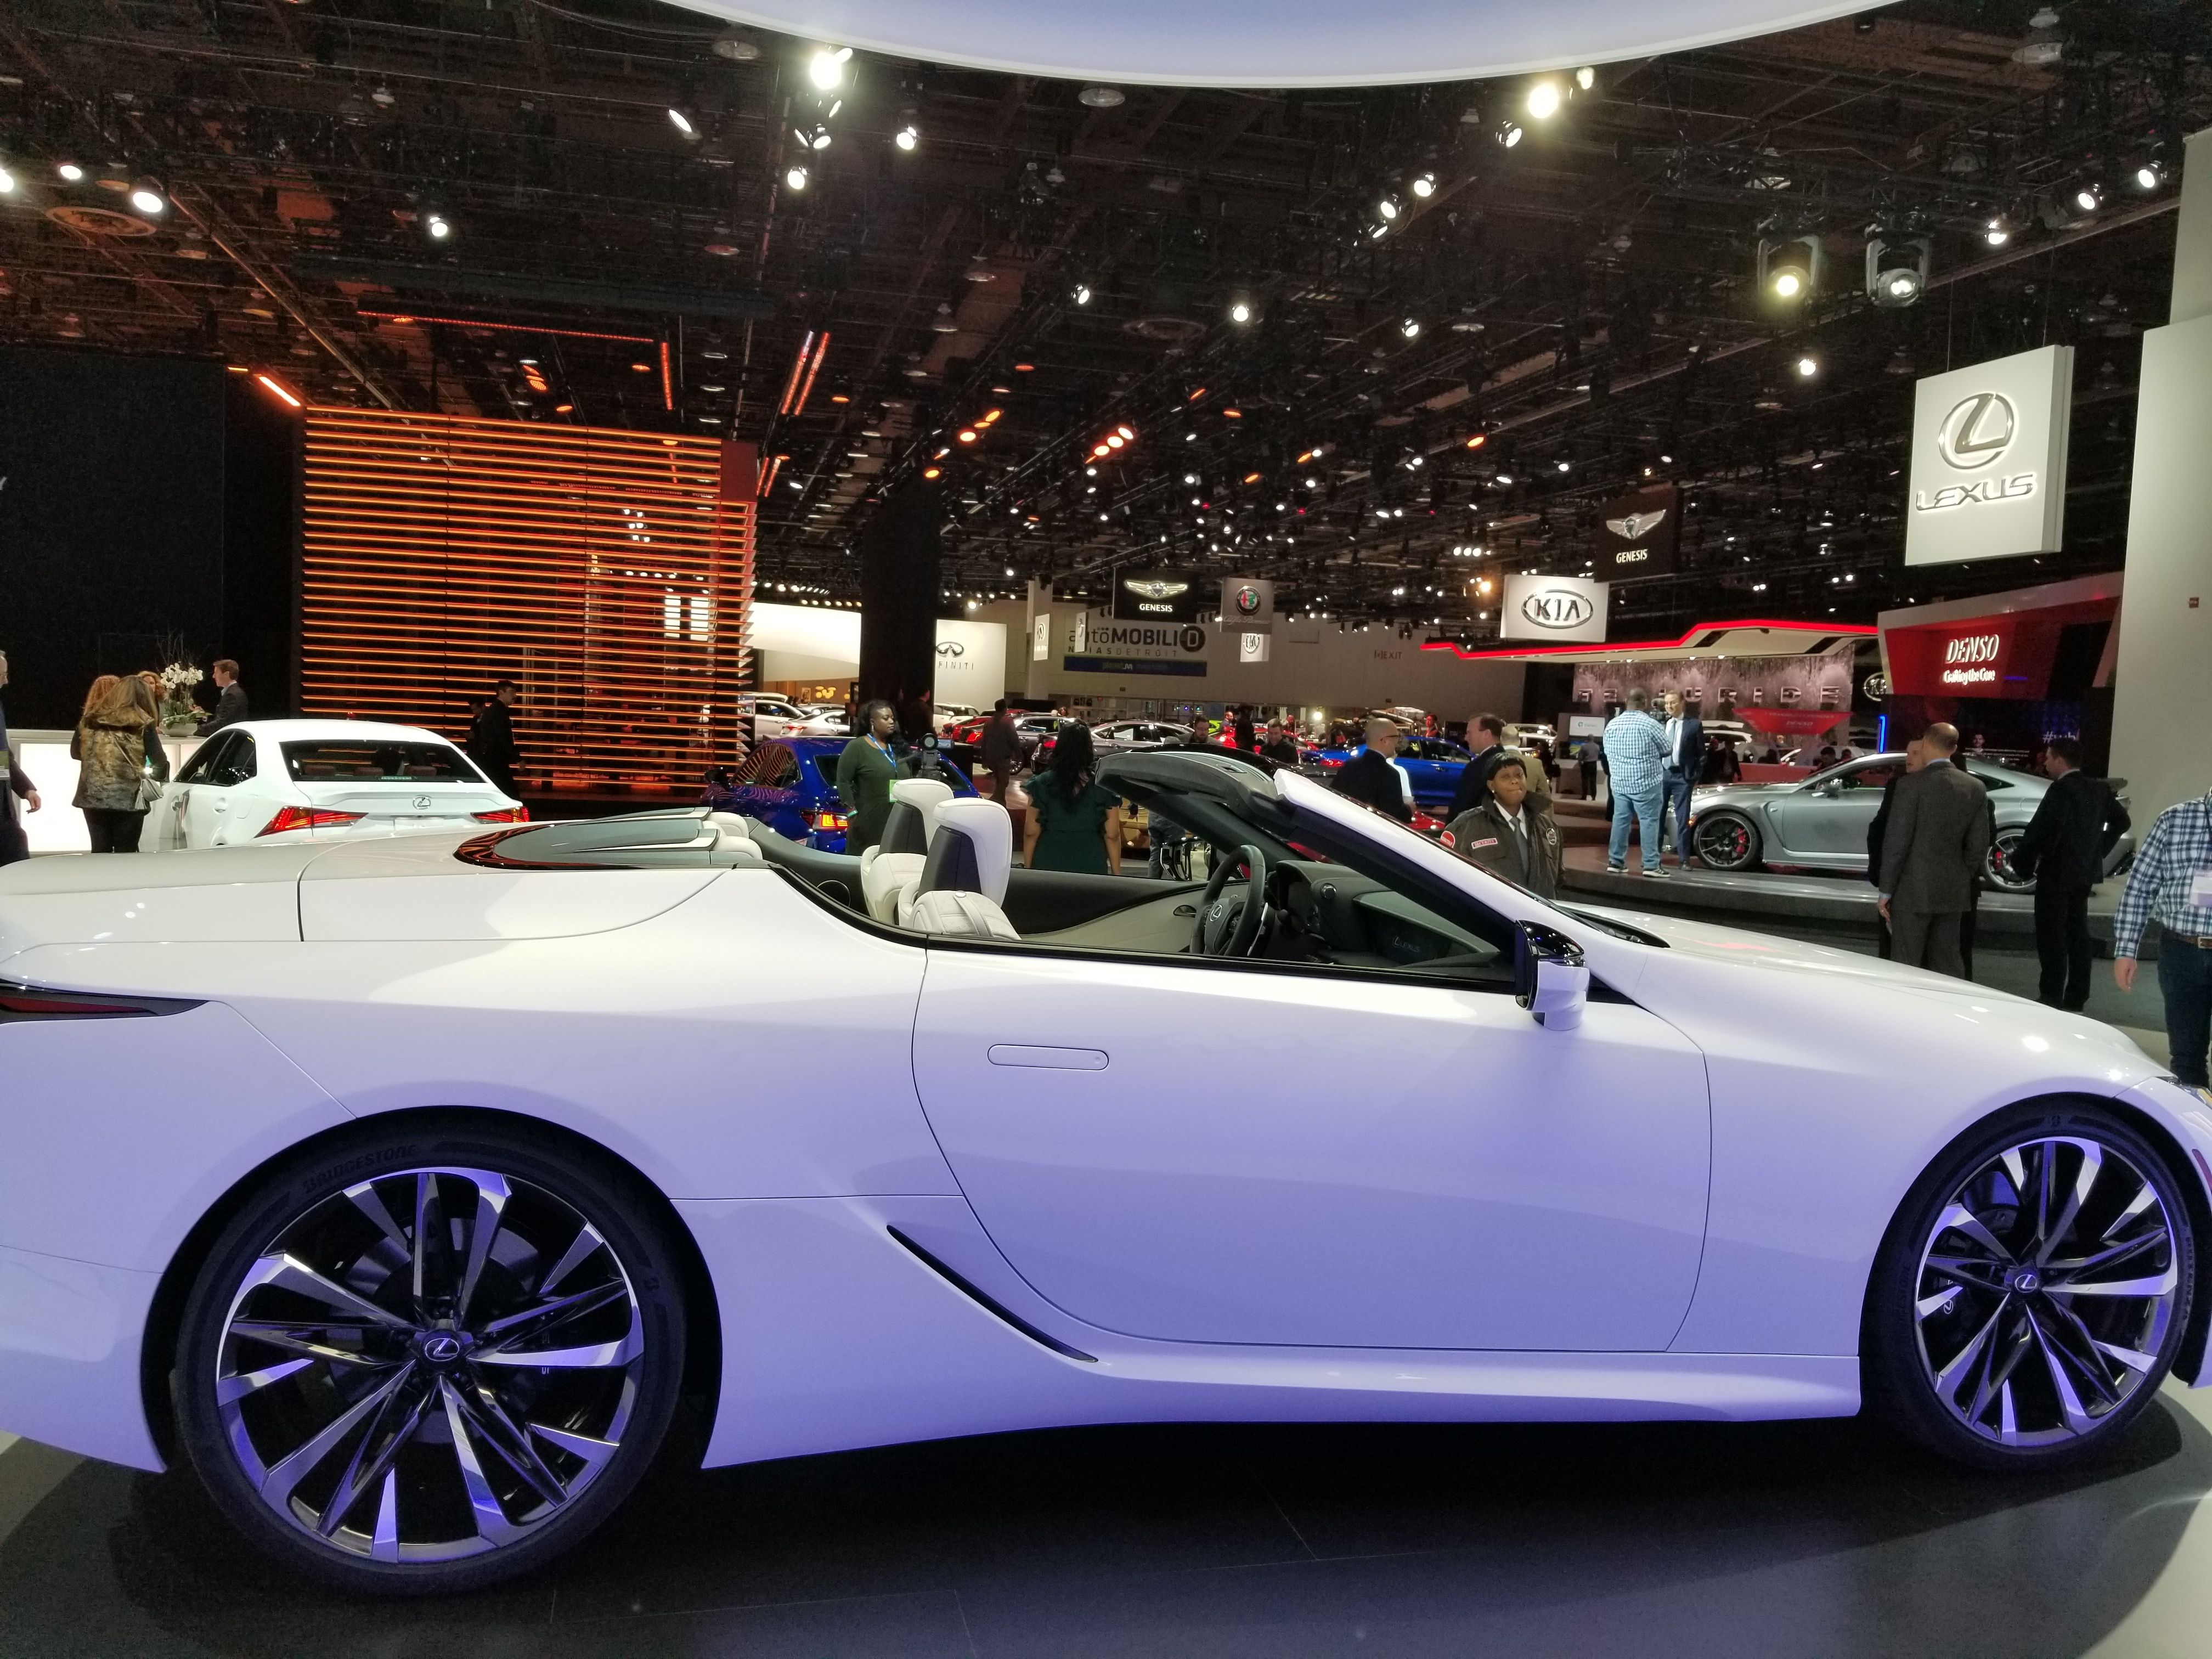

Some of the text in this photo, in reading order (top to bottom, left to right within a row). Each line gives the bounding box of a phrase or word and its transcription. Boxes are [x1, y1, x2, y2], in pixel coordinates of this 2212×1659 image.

[1915, 473, 2035, 511] LEXUS
[1616, 549, 1648, 563] GENESIS
[1139, 603, 1173, 612] GENESIS
[1534, 598, 1580, 621] KIA
[1945, 634, 1999, 664] DENSO
[938, 661, 974, 670] FINITI
[1579, 686, 1839, 704] TEURIDE
[302, 1144, 417, 1194] BRIDGESTONE
